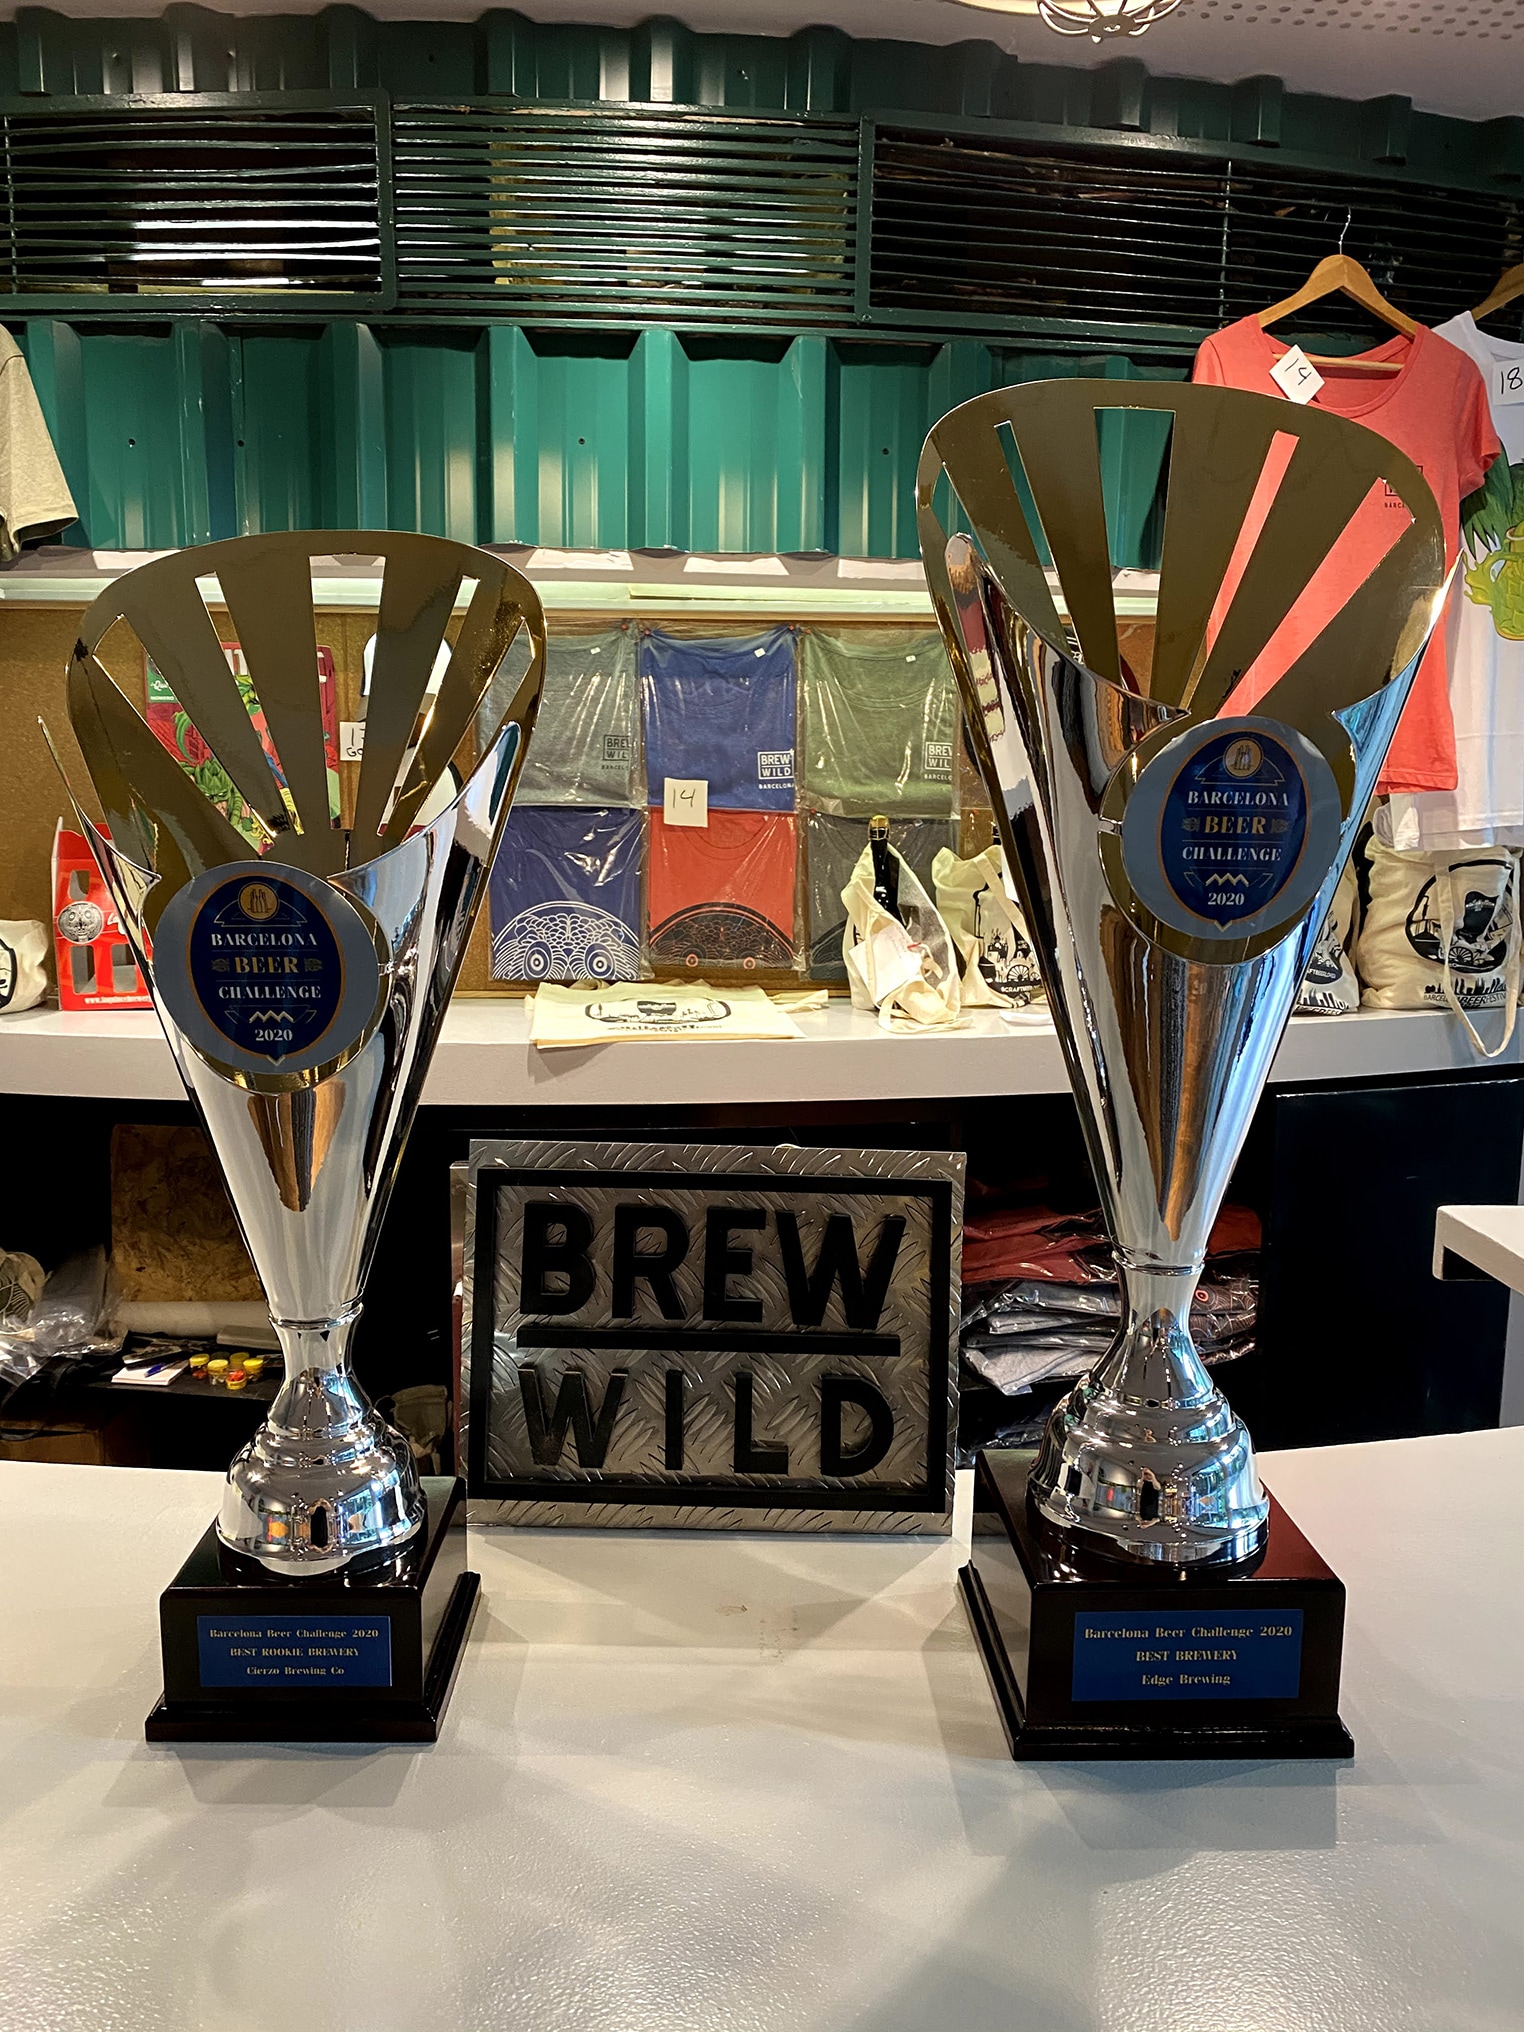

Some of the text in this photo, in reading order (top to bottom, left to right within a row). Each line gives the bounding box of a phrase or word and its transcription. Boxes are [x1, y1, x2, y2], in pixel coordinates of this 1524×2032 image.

[1501, 367, 1523, 394] 18
[607, 751, 628, 759] WIL
[761, 754, 790, 765] BREW
[929, 758, 950, 768] WIL
[762, 767, 791, 777] WILD
[673, 788, 696, 808] 14
[1187, 790, 1289, 806] BARCELONA
[1204, 816, 1266, 834] BEER
[1182, 846, 1282, 861] CHALLENGE
[1207, 892, 1245, 906] 2020
[211, 933, 318, 946] BARCELONA
[235, 957, 299, 973] BEER
[218, 986, 321, 998] CHALLENGE
[255, 1029, 293, 1041] 2020
[519, 1201, 907, 1330] BREW
[518, 1363, 896, 1477] WILD
[209, 1629, 379, 1639] Barcelona Beer Challenge 2020
[1084, 1626, 1292, 1639] Barcelona Beer Challenge 2020
[230, 1647, 359, 1657] BEST ROOKIE BREWERY
[1136, 1650, 1238, 1662] BEST BREWERY
[246, 1666, 345, 1676] Cierzo Brewing Co
[1141, 1673, 1231, 1686] Edge Brewing
